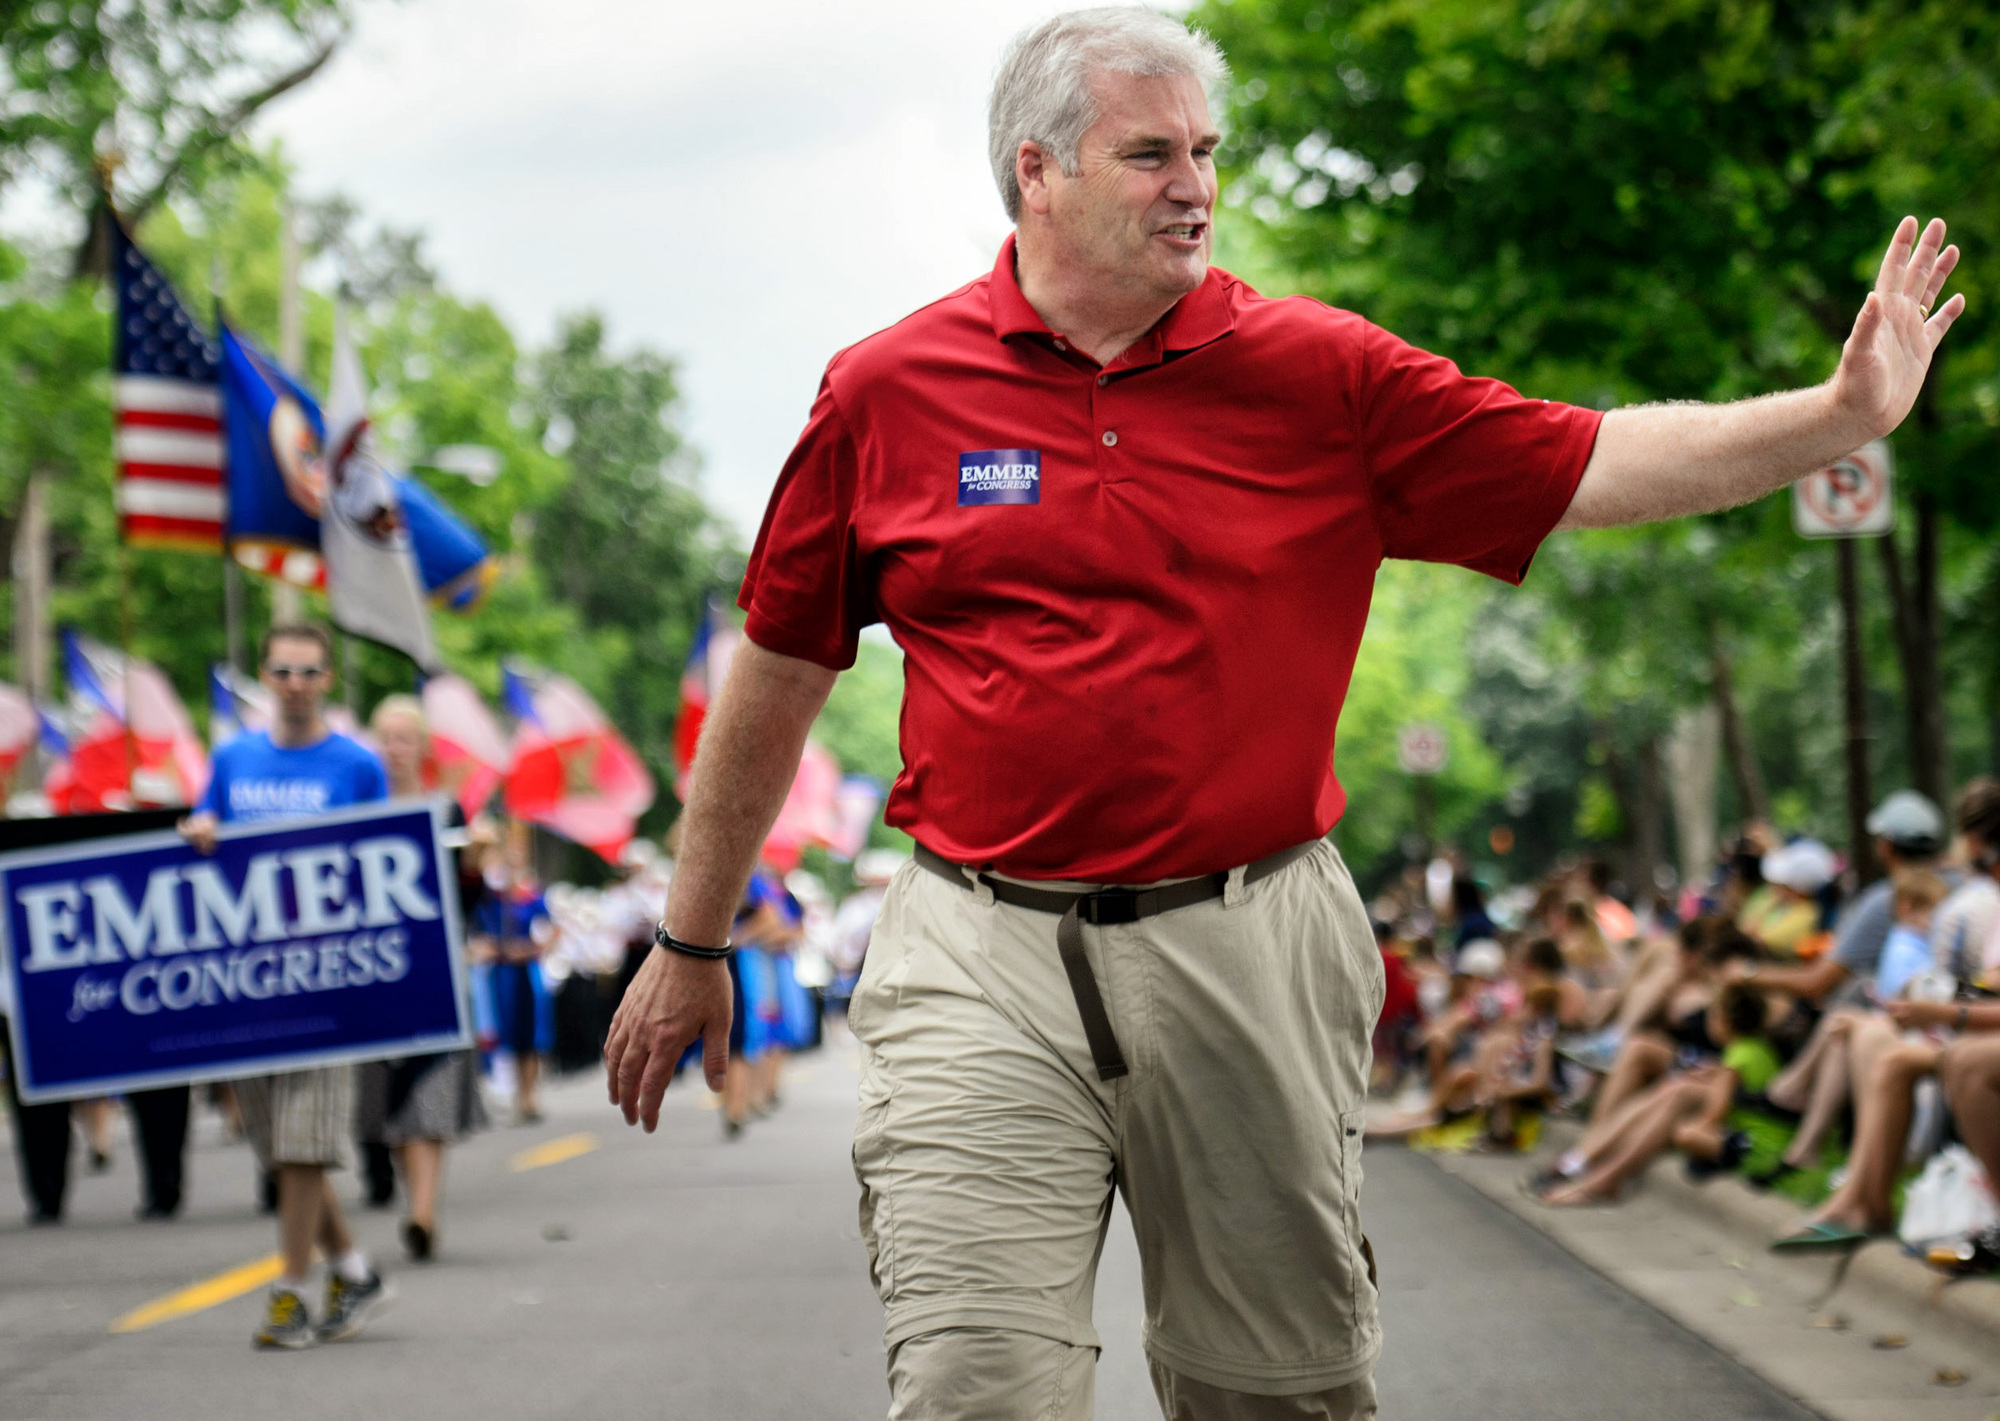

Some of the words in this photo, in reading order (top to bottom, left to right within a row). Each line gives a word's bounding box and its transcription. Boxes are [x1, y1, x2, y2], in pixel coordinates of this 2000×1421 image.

[960, 464, 1039, 483] EMMER
[966, 482, 976, 492] for
[976, 480, 1032, 491] CONGRESS
[17, 835, 442, 973] EMMER
[67, 971, 118, 1022] for
[120, 928, 411, 1015] CONGRESS
